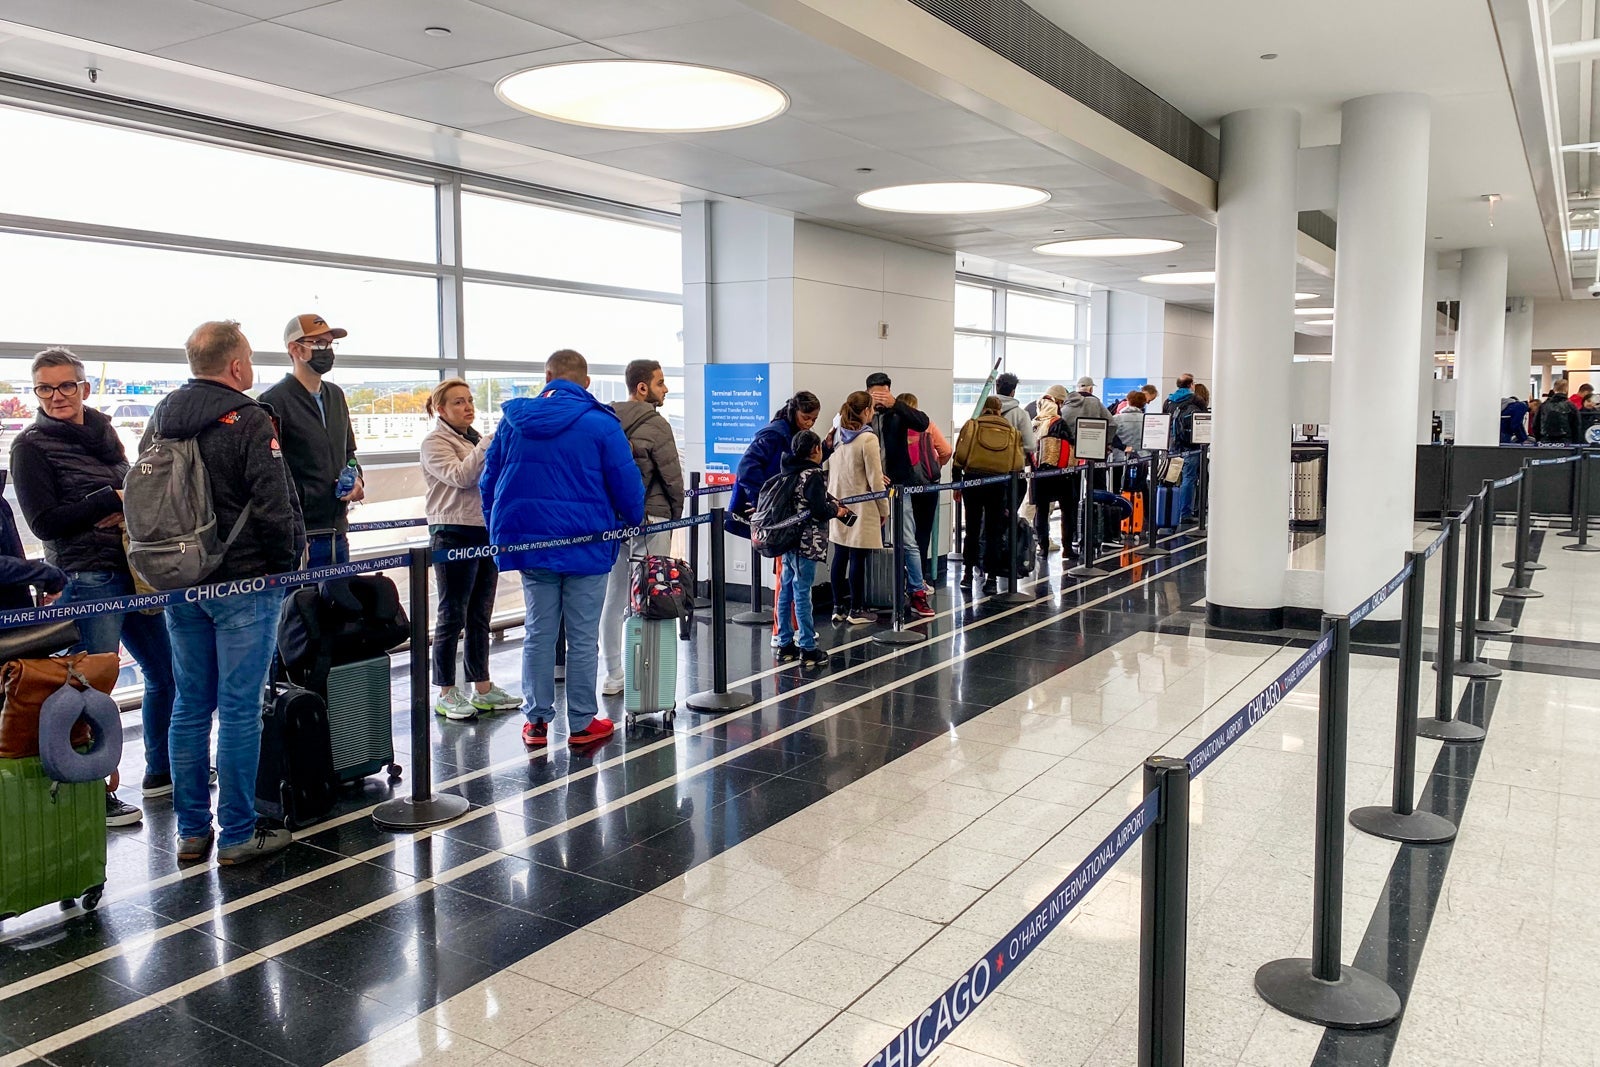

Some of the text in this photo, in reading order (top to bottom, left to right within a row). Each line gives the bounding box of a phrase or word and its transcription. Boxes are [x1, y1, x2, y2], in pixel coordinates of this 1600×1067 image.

[964, 478, 981, 487] CHICAGO
[447, 535, 593, 561] CHICAGO O'HARE INTERNATIONAL AIRPORT
[602, 515, 711, 541] CHICAGO O'HARE INTERNATIONAL AIRPORT
[0, 557, 403, 624] 'HARE INTERNATIONAL AIRPORT CHICAGO O'HARE INTERNATIONAL AIRPORT
[1189, 732, 1226, 774] NTERNATIONAL
[1226, 716, 1244, 741] AIRPORT
[1248, 681, 1281, 726] CHICAGO
[1009, 907, 1048, 960] O'HARE
[1049, 840, 1116, 921] INTERNATIONAL
[1115, 808, 1145, 853] AIRPORT
